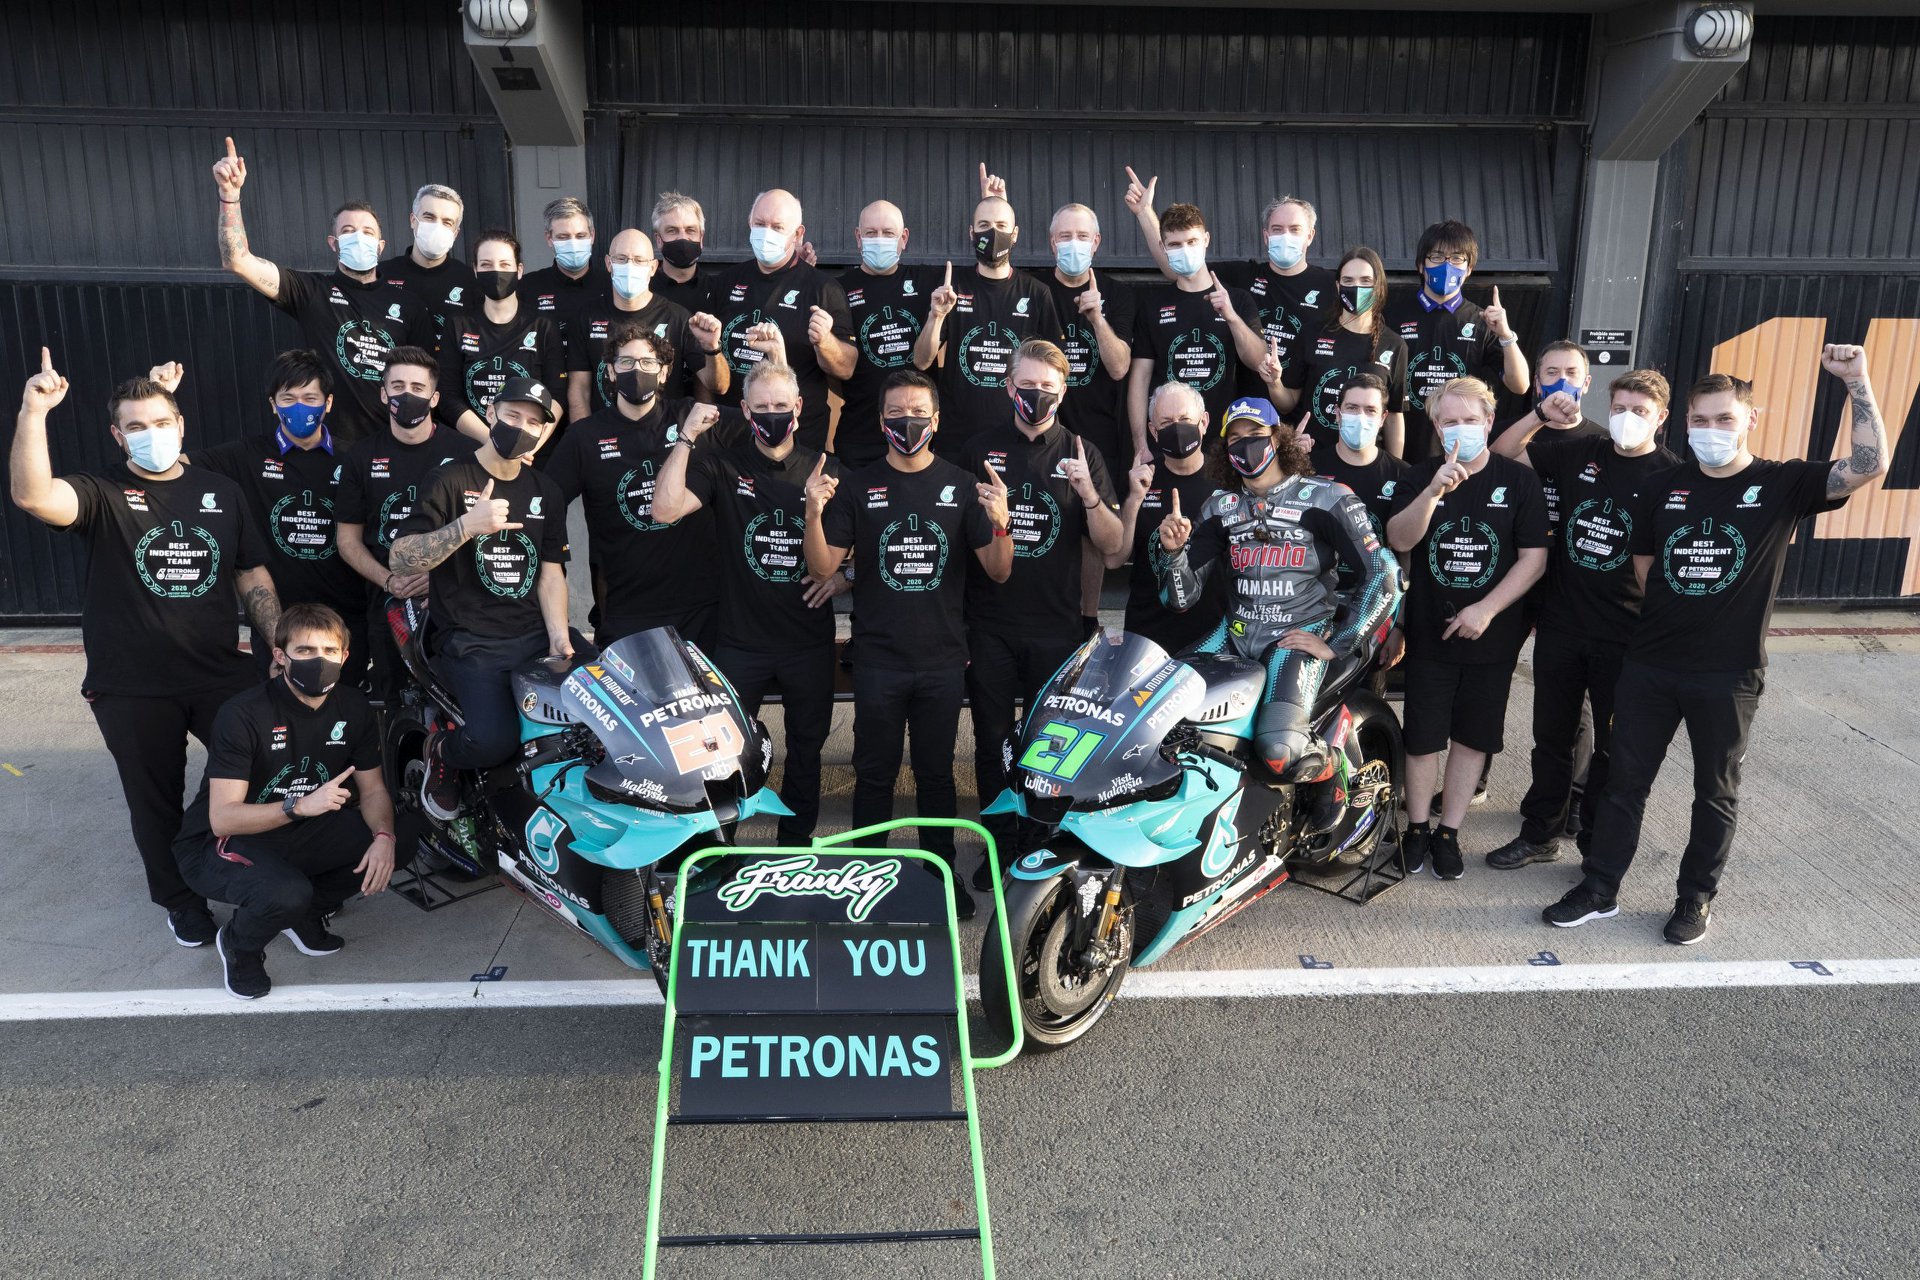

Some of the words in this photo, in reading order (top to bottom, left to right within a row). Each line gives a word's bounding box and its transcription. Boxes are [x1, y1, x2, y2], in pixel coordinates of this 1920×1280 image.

[870, 326, 912, 338] INDEPENDENT
[1264, 328, 1296, 340] EPENDENT
[1264, 334, 1282, 343] TEM
[360, 335, 377, 344] BEST
[970, 346, 1012, 354] INDEPENDENT
[628, 488, 656, 498] INDEPE
[282, 516, 332, 525] INDEPENDENT
[1008, 510, 1049, 520] DEPENDENT
[1592, 516, 1611, 526] BEST
[1576, 519, 1625, 538] INDEPENDENT
[1587, 530, 1608, 540] TEAM
[755, 535, 802, 545] INDEPENDENT
[1585, 540, 1613, 550] PETRONAS
[770, 544, 789, 552] TEAM
[1231, 541, 1306, 573] Sprinta
[1583, 554, 1598, 564] 2020
[1238, 578, 1294, 596] YAMAHA
[1254, 604, 1283, 614] Visit
[1359, 592, 1392, 636] PETRONAS
[1070, 686, 1094, 699] YAMAHA
[564, 676, 618, 732] PETRONAS
[640, 692, 732, 728] PETRONAS
[1146, 676, 1202, 730] PETRONAS
[1044, 694, 1126, 727] PETRONAS
[661, 707, 745, 775] 20
[1017, 720, 1108, 783] 21
[642, 778, 664, 792] Visit
[1112, 773, 1133, 786] Visit
[619, 778, 669, 803] Malaysia
[1098, 776, 1144, 804] Malaysia
[519, 849, 590, 909] PETRONAS
[1182, 849, 1256, 908] PETRONAS
[718, 856, 900, 921] Franky
[687, 939, 810, 978] THANK
[843, 939, 927, 977] YOU
[690, 1034, 941, 1078] PETRONAS
